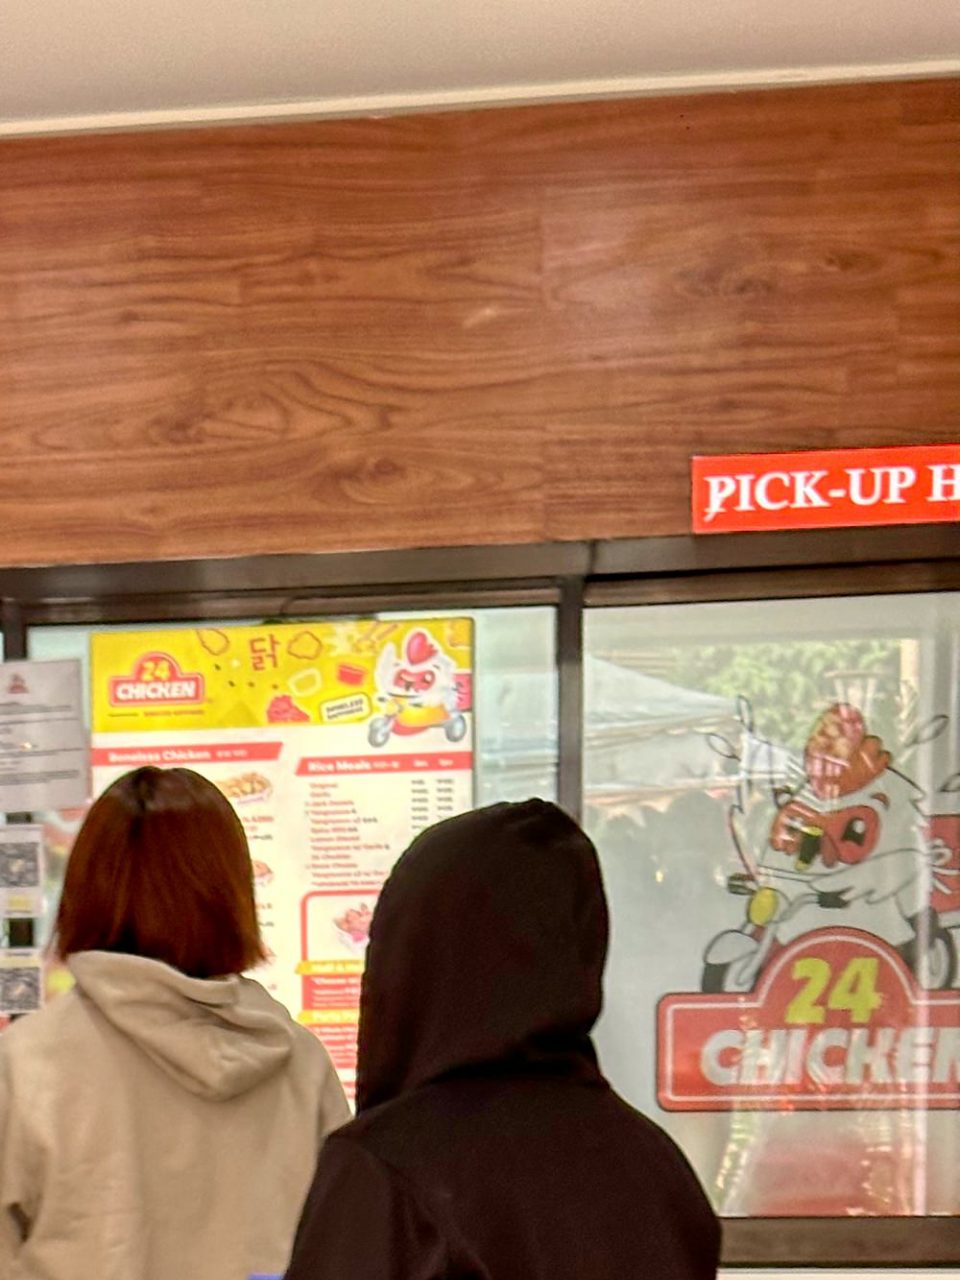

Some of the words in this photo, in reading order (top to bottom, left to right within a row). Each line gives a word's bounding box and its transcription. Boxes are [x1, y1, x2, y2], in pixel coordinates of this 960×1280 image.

[704, 465, 917, 522] PICK-UP
[249, 634, 280, 671] 닭
[141, 660, 171, 681] 24
[116, 681, 196, 700] CHICKEN
[162, 749, 211, 761] Chicken
[307, 761, 334, 772] Rice
[336, 759, 372, 772] Meals
[785, 957, 882, 1024] 24
